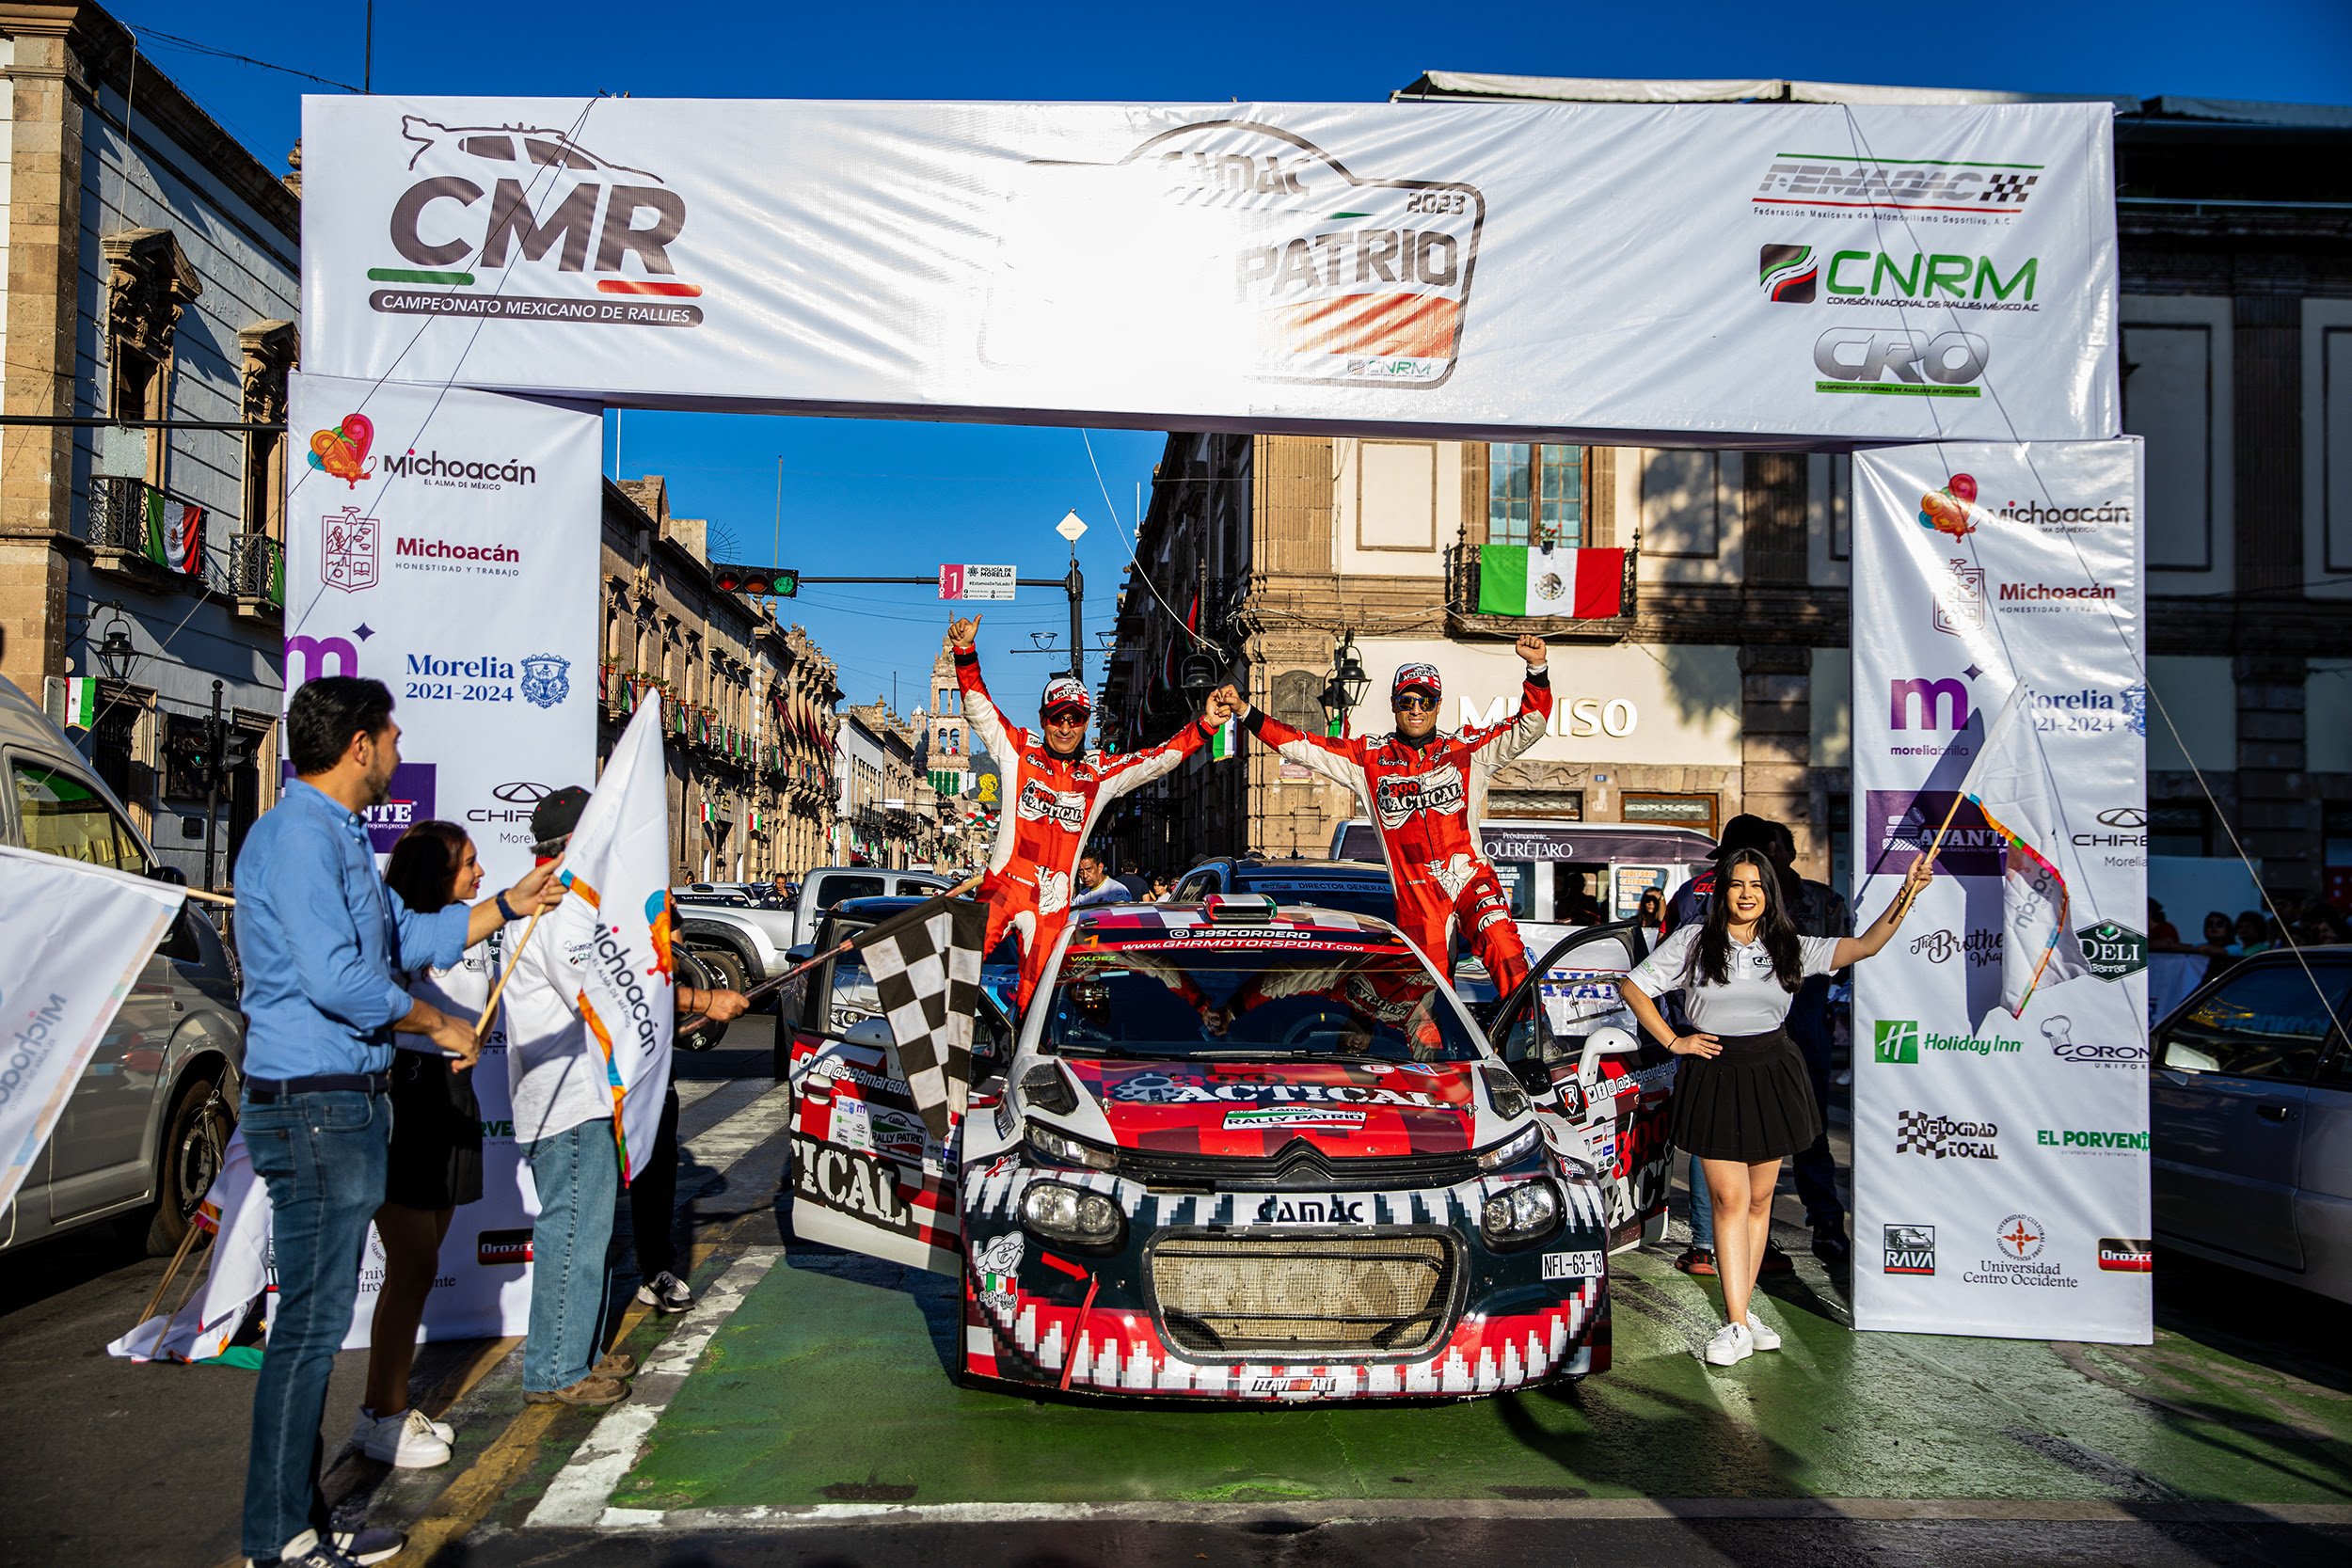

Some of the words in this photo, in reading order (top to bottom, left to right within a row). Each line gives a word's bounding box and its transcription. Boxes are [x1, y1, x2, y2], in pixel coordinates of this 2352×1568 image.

[1757, 164, 1983, 201] FEMADAC
[1406, 193, 1466, 214] 2023
[1754, 207, 1806, 218] Federación
[1810, 210, 1853, 220] Mexicana
[1858, 212, 1869, 220] de
[390, 176, 686, 275] CMR
[1236, 230, 1458, 302] PATRIO
[1826, 250, 2039, 301] CNRM
[381, 294, 501, 313] CAMPEONATO
[505, 300, 596, 319] MEXICANO
[600, 304, 624, 320] DE
[627, 306, 691, 324] RALLIES
[1827, 296, 1875, 308] COMISIÓN
[1875, 298, 1926, 309] NACIONAL
[1927, 300, 1941, 309] DE
[1943, 301, 1982, 310] RALLIES
[1982, 301, 2022, 311] MÉXICO
[1814, 326, 1990, 384] CRO
[384, 449, 536, 485] Michoacán
[424, 478, 432, 486] EL
[435, 479, 456, 487] ALMA
[470, 480, 501, 490] MÉXICO
[396, 537, 519, 563] Michoacán
[395, 562, 462, 573] HONESTIDAD
[476, 567, 519, 577] TRABAJO
[949, 572, 957, 592] 1
[1999, 582, 2116, 600] Michoacán
[405, 653, 515, 680] Morelia
[405, 682, 515, 704] 2021-2024
[1459, 695, 1638, 738] MIISO
[2033, 717, 2115, 732] 21-2024
[1034, 788, 1056, 805] 399
[1390, 783, 1419, 799] 399
[361, 803, 412, 822] NTE
[467, 809, 534, 822] CHIR
[500, 832, 534, 844] Morel
[1920, 829, 2010, 847] AVANT
[2073, 833, 2148, 847] CHIRE
[1484, 839, 1573, 860] QUERÉTARO
[1084, 935, 1099, 948] 1
[1193, 929, 1311, 940] 399CORDERO
[1910, 934, 1935, 955] The
[1928, 928, 2004, 963] Brothe
[2079, 938, 2139, 962] DELI
[1923, 1033, 1992, 1055] Holiday
[1994, 1035, 2022, 1052] Inn
[2054, 1044, 2150, 1059] CORON
[1227, 1116, 1289, 1124] RALLY
[1920, 1119, 1998, 1138] VELOCIDAD
[872, 1131, 895, 1143] RALLY
[897, 1132, 923, 1144] PATRIO
[2037, 1130, 2059, 1146] EL
[2063, 1131, 2151, 1151] PORVENI
[1948, 1141, 1998, 1160] TOTAL
[1258, 1202, 1363, 1222] CAMAC
[1544, 1254, 1603, 1277] NFL-63-13
[1885, 1252, 1934, 1268] RAVA
[1980, 1260, 2060, 1275] Universidad
[1963, 1271, 2009, 1285] Centro
[2010, 1274, 2078, 1288] Occidente
